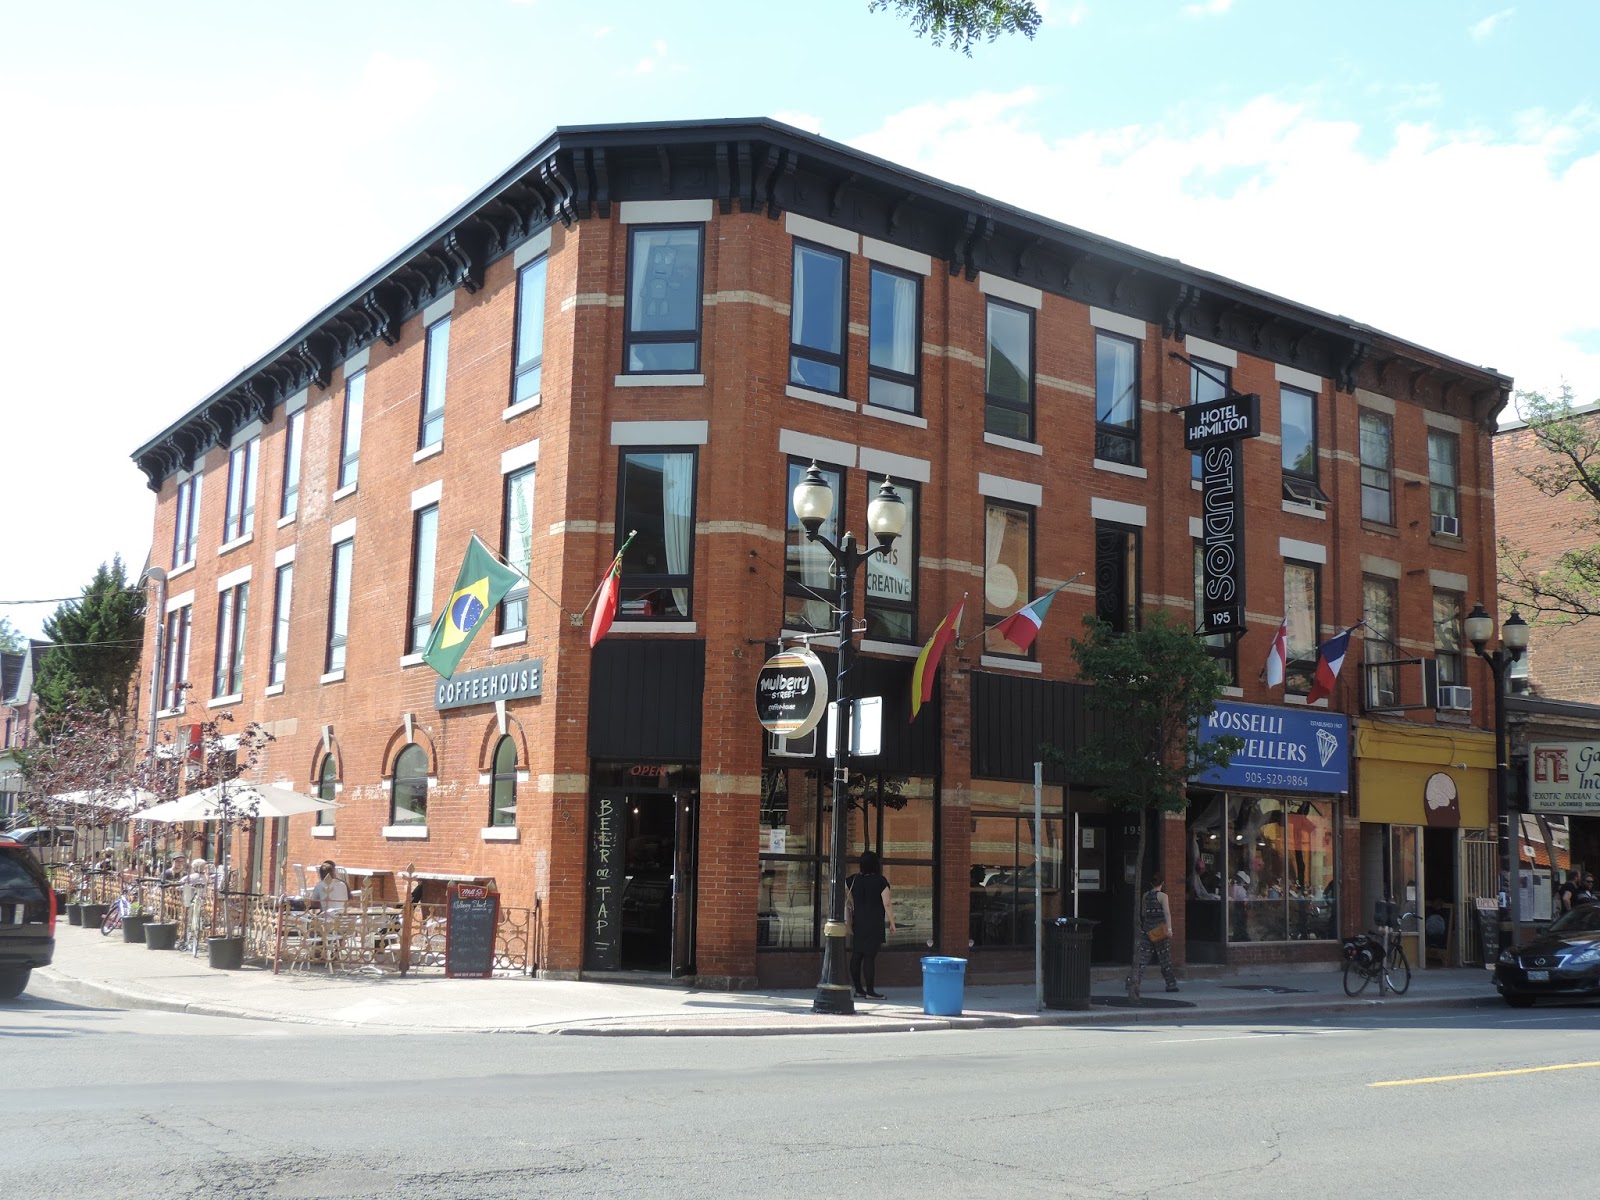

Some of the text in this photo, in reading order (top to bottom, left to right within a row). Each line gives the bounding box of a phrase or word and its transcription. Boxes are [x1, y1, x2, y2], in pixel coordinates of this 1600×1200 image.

[1200, 404, 1239, 424] HOTEL
[1204, 446, 1236, 601] STUDIOS
[867, 572, 910, 596] CREATIVE
[1212, 611, 1231, 625] 195
[438, 667, 540, 705] COFFEEHOUSE
[760, 673, 810, 696] Mulberry
[771, 689, 796, 699] STREET
[1208, 710, 1283, 735] ROSSELLI
[1236, 739, 1307, 762] WELLERS
[630, 764, 668, 777] OPEN
[1245, 771, 1309, 787] 905-529-9864
[1564, 792, 1592, 800] INDIAN
[598, 799, 614, 864] BEER
[596, 886, 611, 935] TAP
